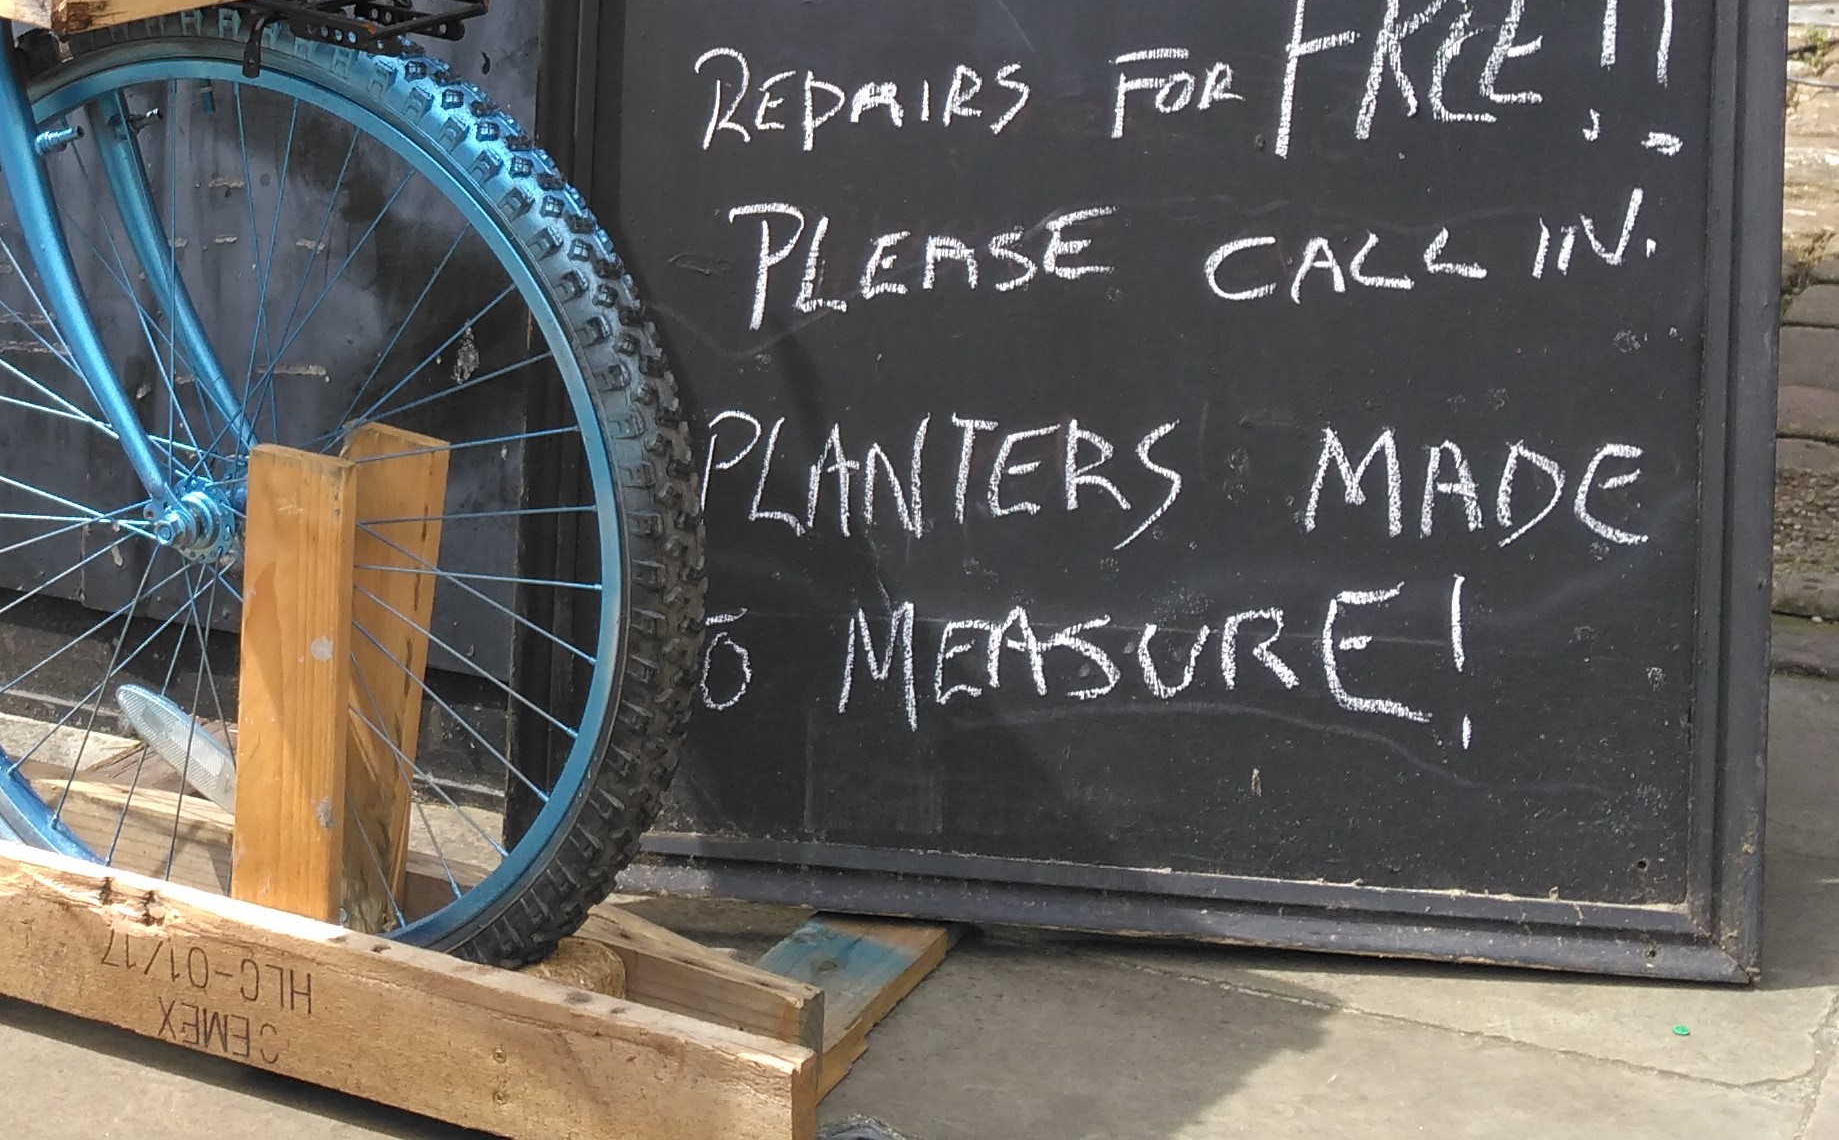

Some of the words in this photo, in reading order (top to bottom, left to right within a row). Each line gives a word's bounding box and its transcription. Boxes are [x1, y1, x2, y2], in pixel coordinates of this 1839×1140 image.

[694, 46, 1030, 152] REPAIRS
[1110, 47, 1245, 139] FOR
[728, 201, 1116, 331] PLEASE
[1203, 217, 1488, 305] CALL
[700, 409, 1182, 550] PLANTERS
[1304, 426, 1649, 548] MADE
[700, 608, 752, 711] O
[838, 573, 1472, 750] MEASURE!
[158, 996, 279, 1065] CEMEX
